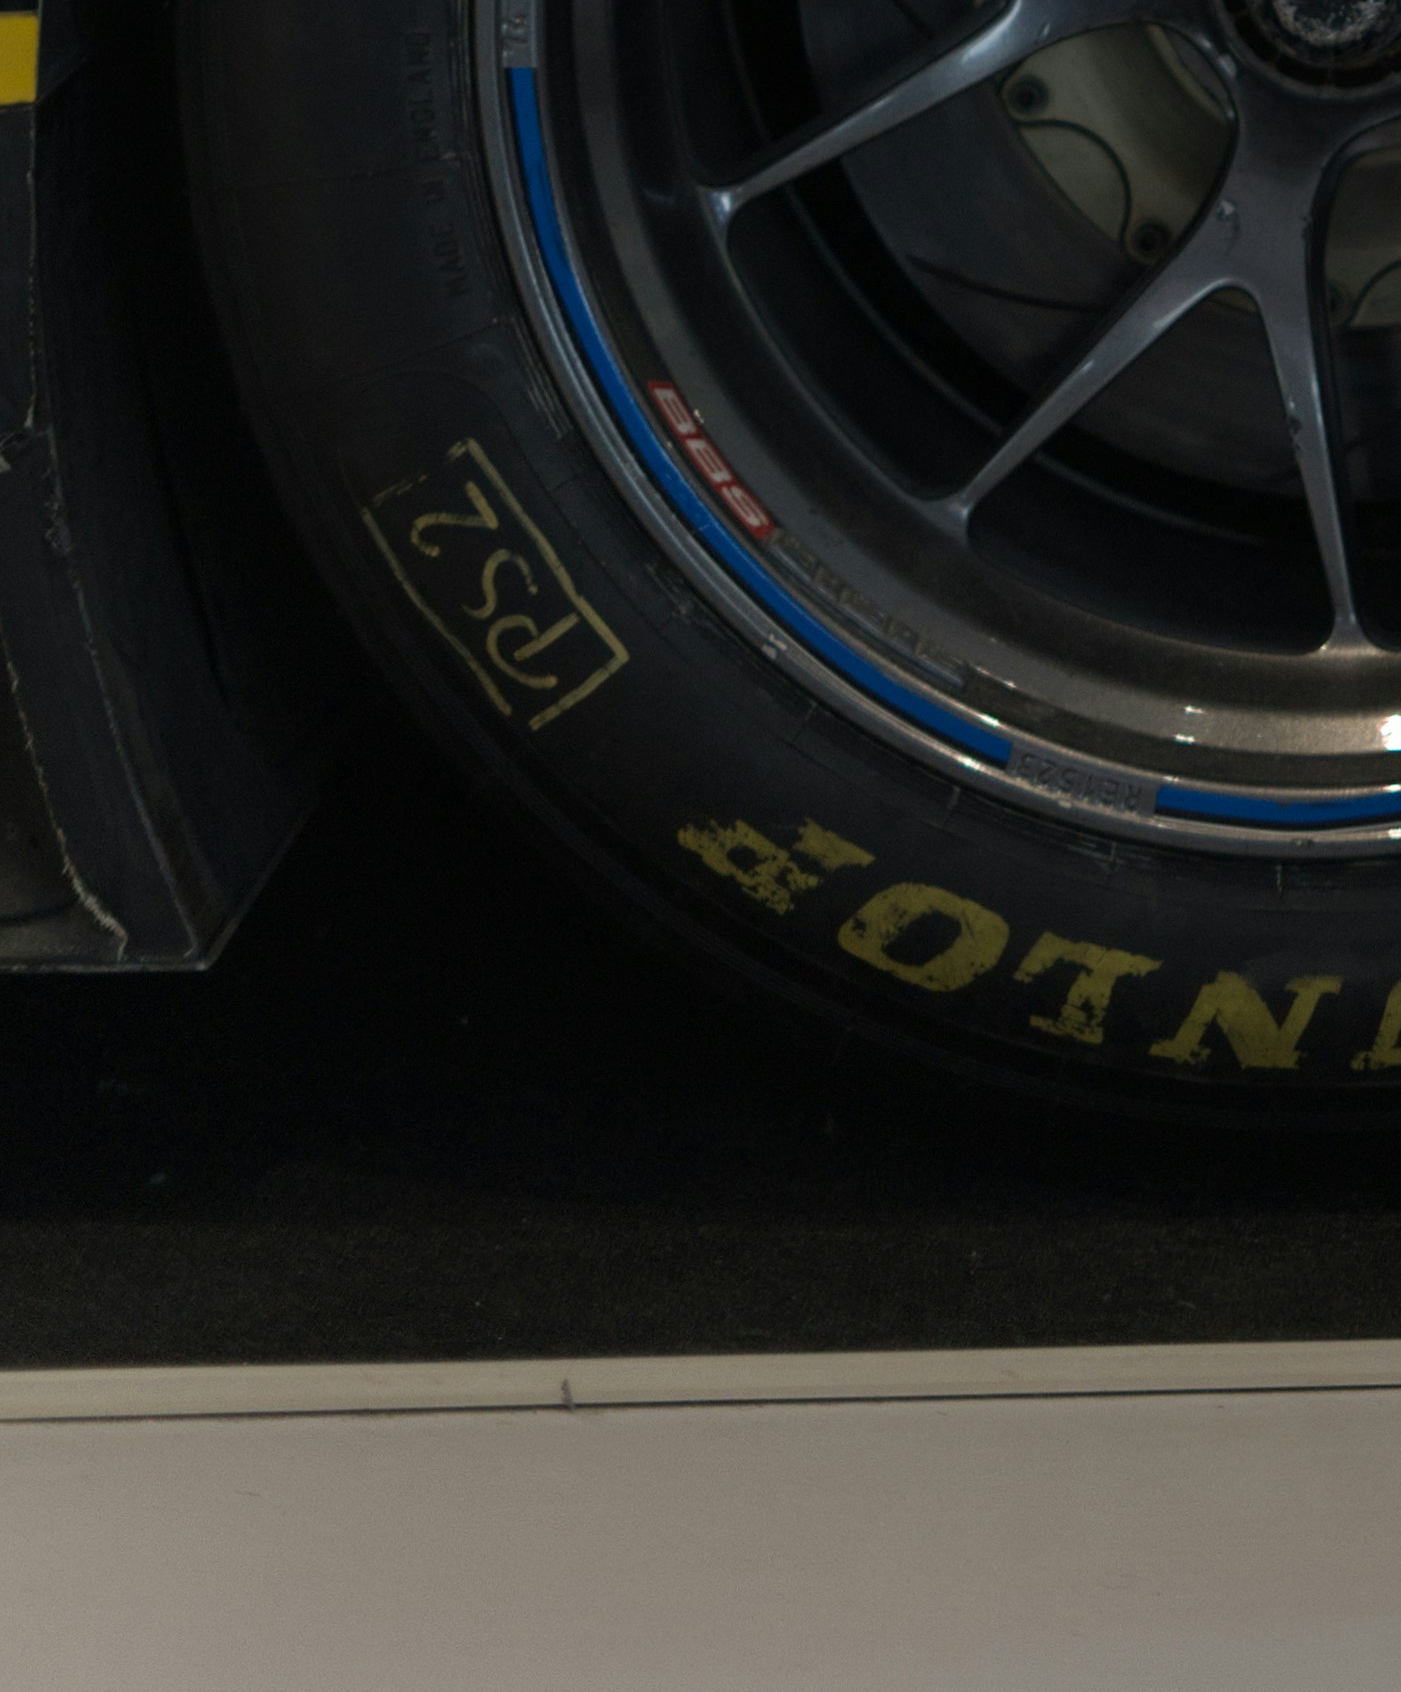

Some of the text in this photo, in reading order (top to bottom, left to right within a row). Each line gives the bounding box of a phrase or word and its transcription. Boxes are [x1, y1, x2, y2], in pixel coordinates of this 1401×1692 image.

[408, 29, 472, 300] MADE IN ENGLAND
[652, 385, 770, 537] BBS
[410, 481, 581, 690] PS2
[1012, 748, 1143, 812] RE1523
